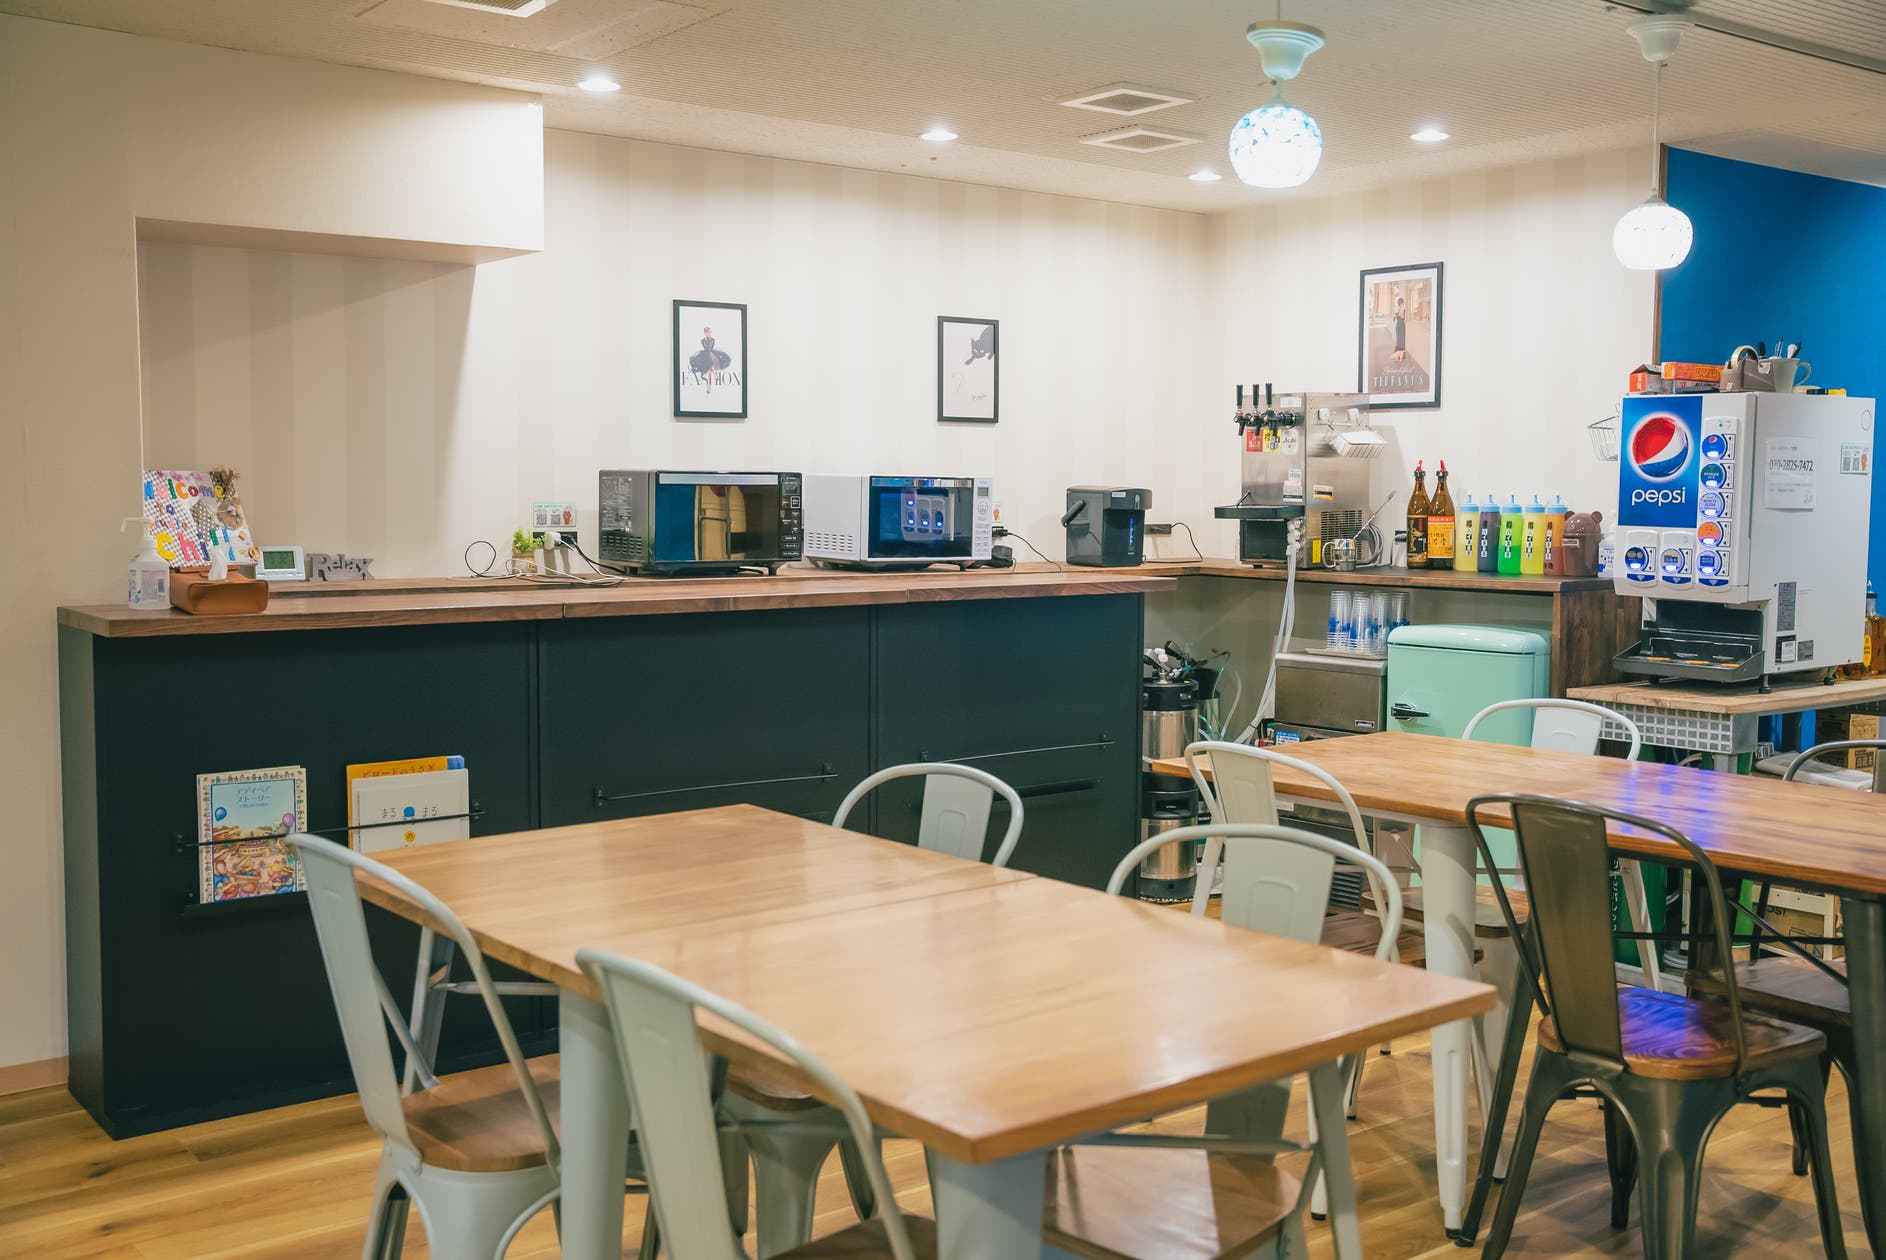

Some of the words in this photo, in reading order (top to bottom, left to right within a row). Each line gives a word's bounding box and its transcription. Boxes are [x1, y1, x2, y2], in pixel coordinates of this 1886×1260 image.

[1631, 486, 1686, 507] pepsi
[306, 553, 375, 582] Relax
[406, 832, 414, 840] の
